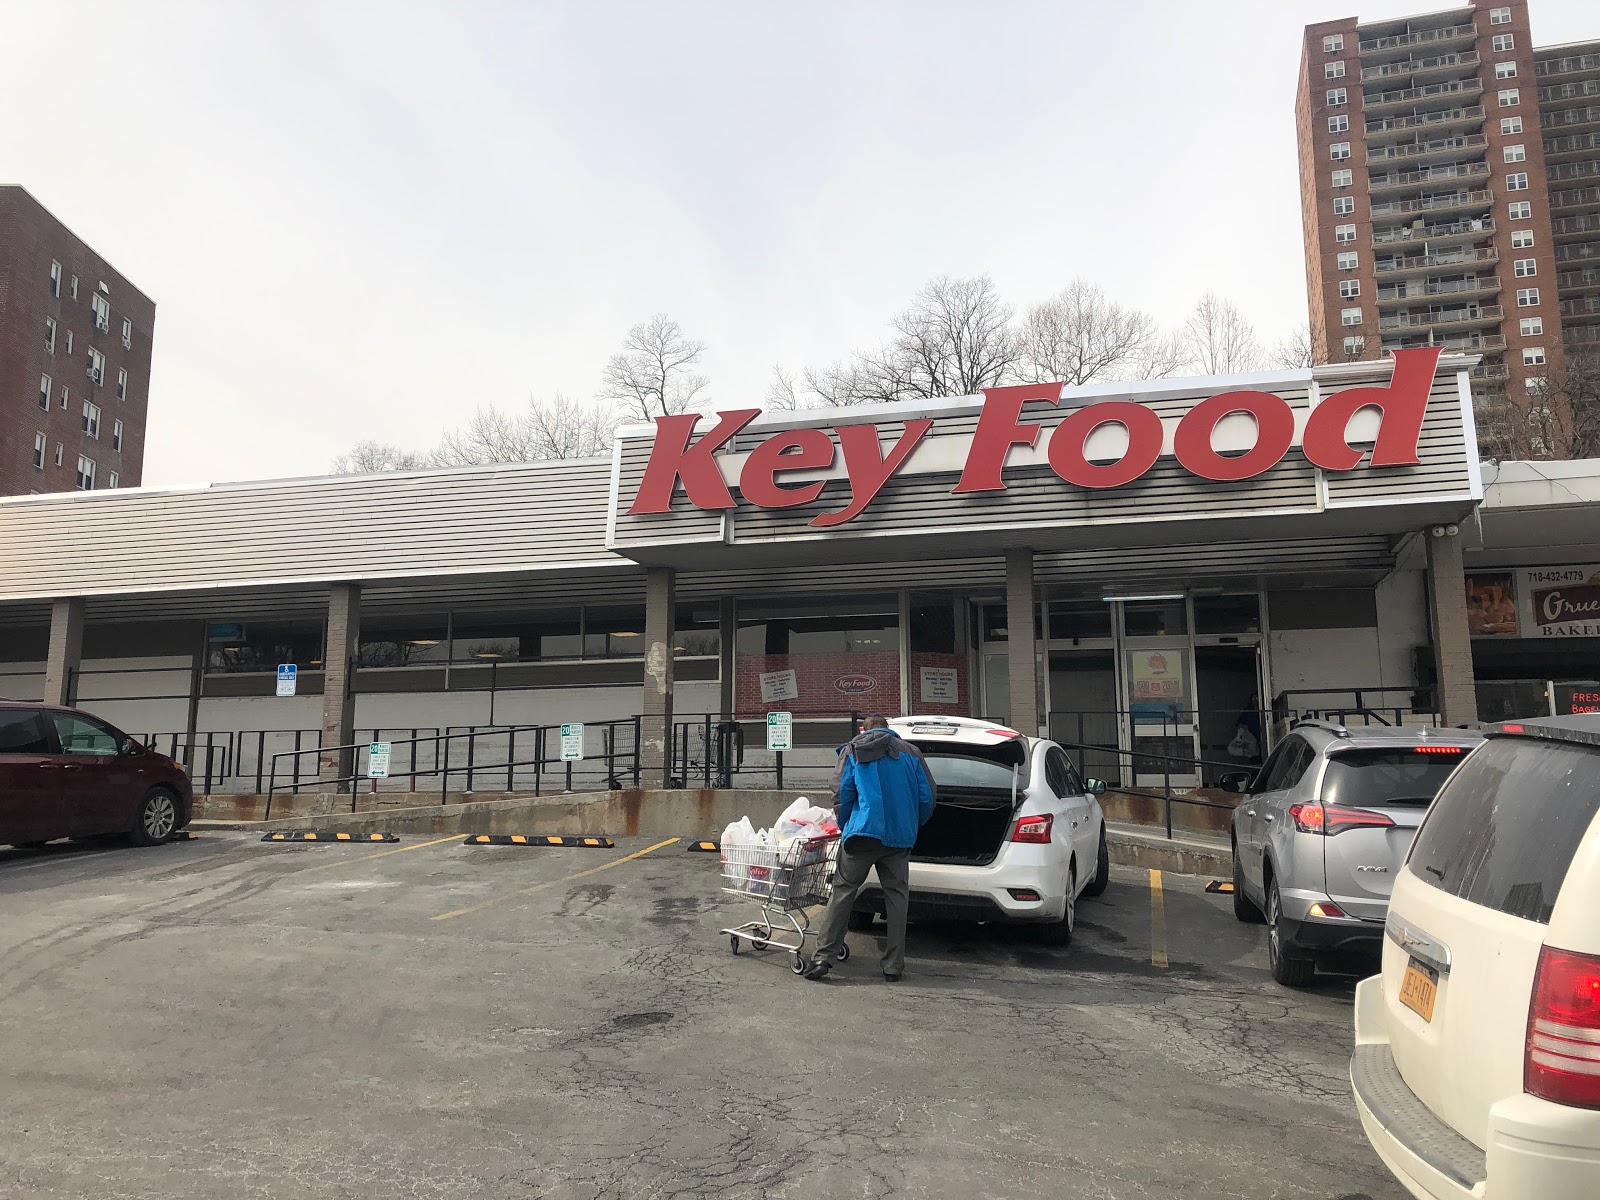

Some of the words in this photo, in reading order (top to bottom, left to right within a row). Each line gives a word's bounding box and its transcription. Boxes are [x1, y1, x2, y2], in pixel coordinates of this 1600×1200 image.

[626, 408, 934, 528] Key
[950, 345, 1445, 495] Food
[1527, 570, 1584, 582] 718-432-4779
[1572, 692, 1600, 702] FRES
[768, 714, 777, 724] 20
[562, 726, 570, 735] 20
